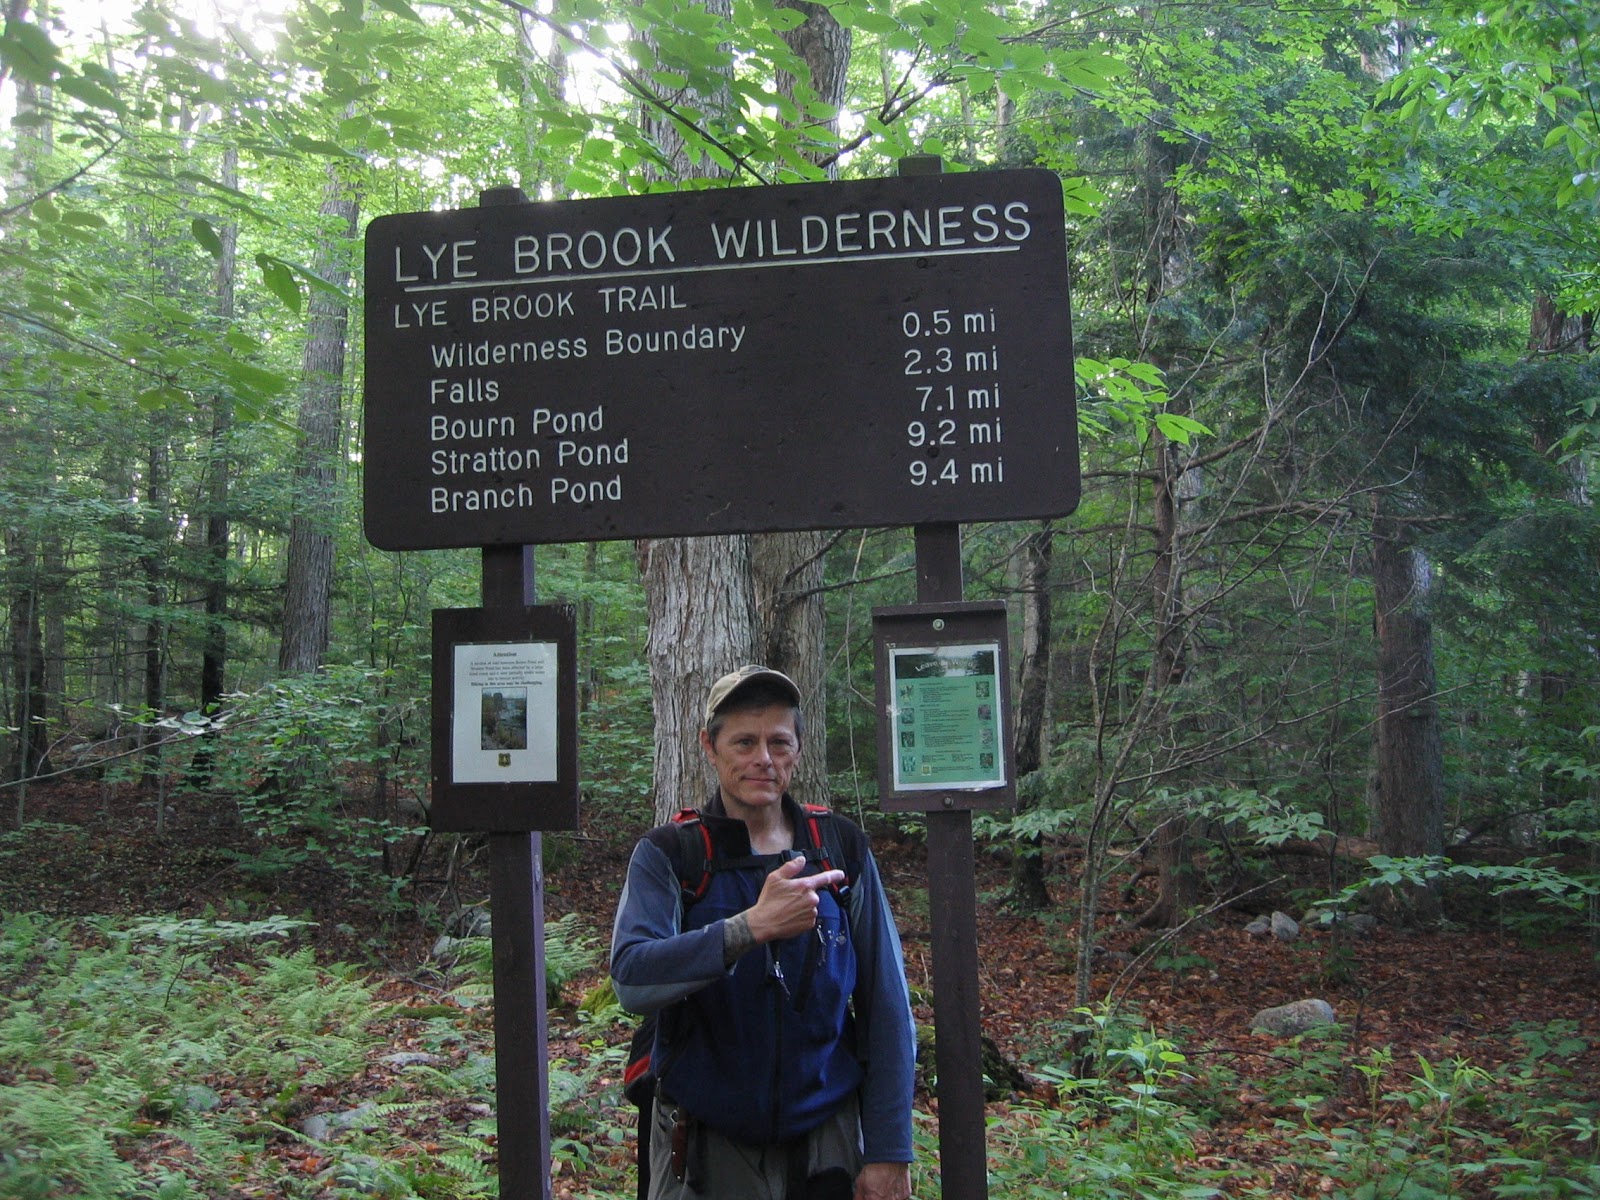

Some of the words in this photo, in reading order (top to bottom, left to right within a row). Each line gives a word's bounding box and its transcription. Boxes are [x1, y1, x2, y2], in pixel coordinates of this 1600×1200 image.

[395, 241, 478, 282] LYE
[514, 226, 675, 274] BROOK
[711, 202, 1031, 258] WILDERNESS
[394, 301, 448, 329] LYE
[471, 291, 575, 323] BROOK
[597, 285, 687, 314] TRAIL
[902, 309, 951, 338] 0.5
[963, 308, 996, 334] mi
[431, 337, 588, 368] Wilderness
[606, 323, 746, 356] Boundary
[904, 347, 953, 376] 2.3
[965, 345, 998, 372] mi
[431, 377, 499, 405] Falls
[915, 385, 955, 412] 7.1
[967, 382, 1000, 410] mi
[431, 415, 515, 441] Bourn
[532, 405, 603, 435] Pond
[907, 418, 956, 447] 9.2
[969, 416, 1001, 444] mi
[431, 446, 540, 475] Stratton
[557, 437, 629, 467] Pond
[909, 458, 959, 486] 9.4
[971, 456, 1003, 484] mi
[431, 483, 533, 513] Branch
[551, 474, 621, 504] Pond
